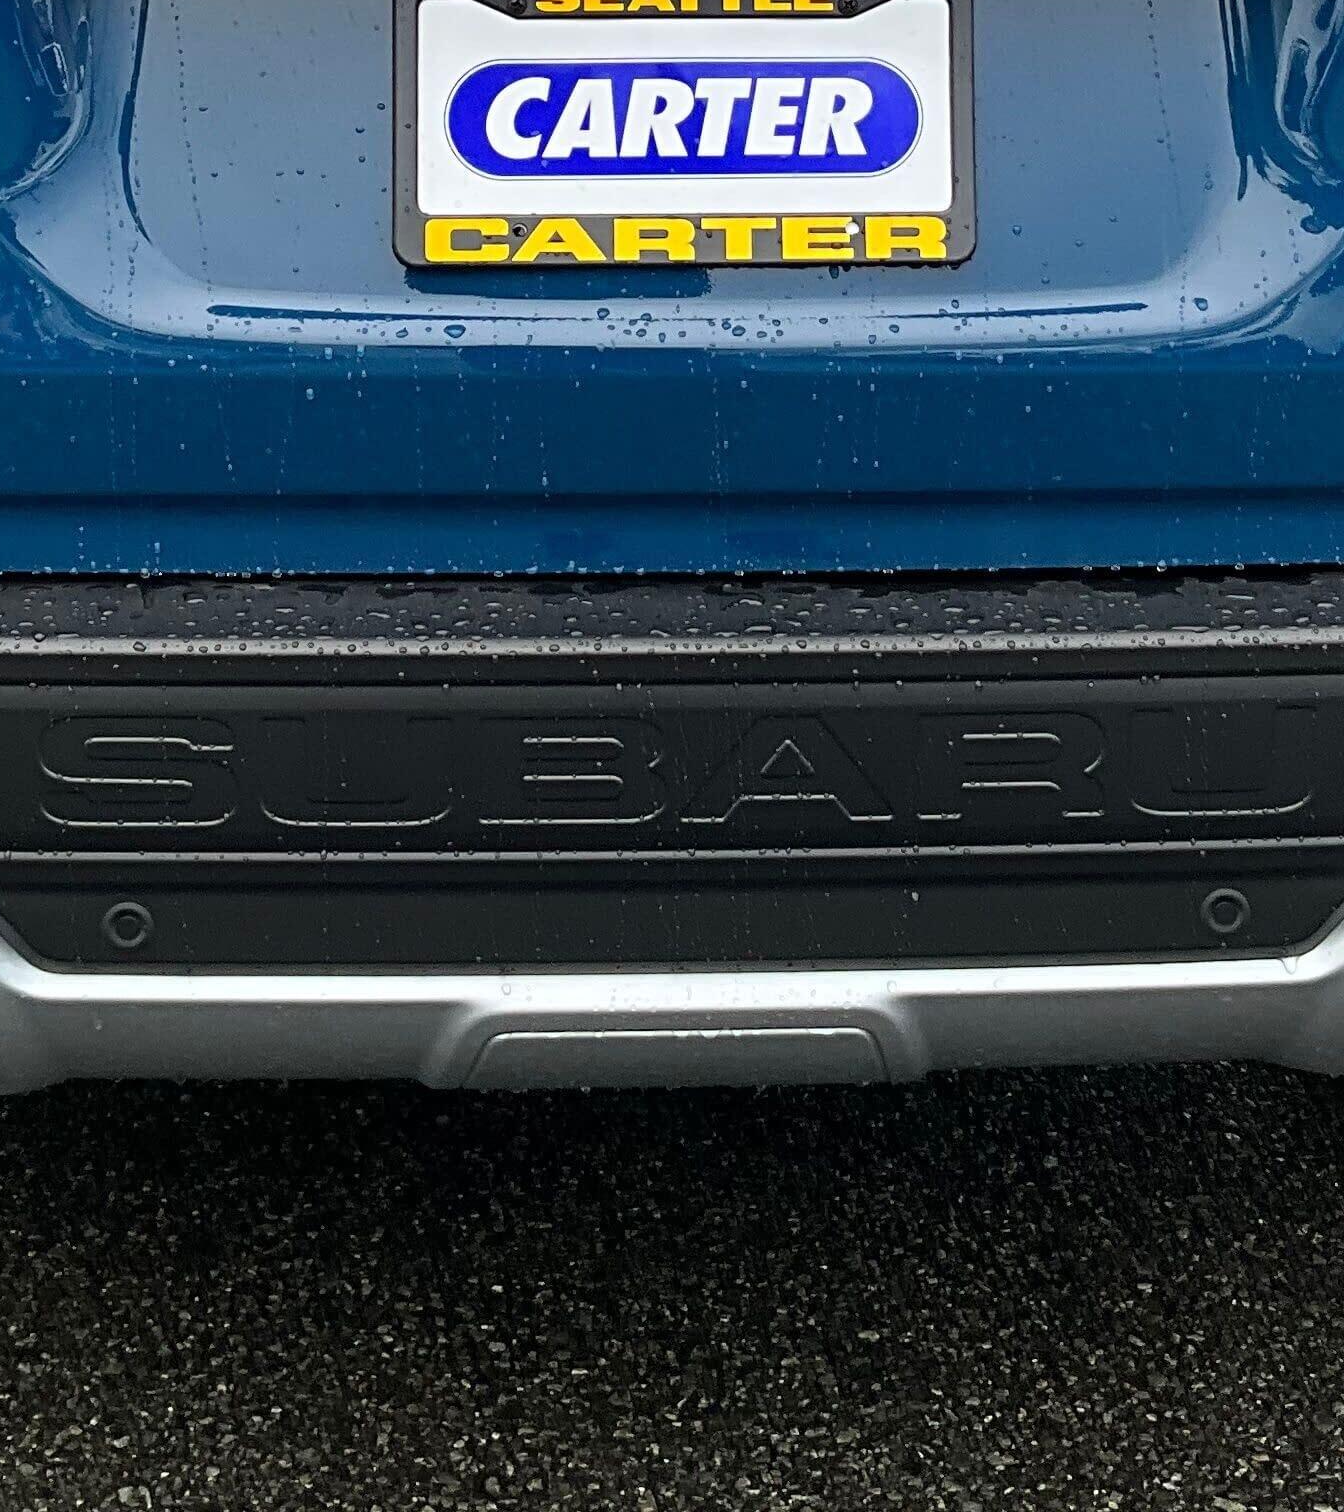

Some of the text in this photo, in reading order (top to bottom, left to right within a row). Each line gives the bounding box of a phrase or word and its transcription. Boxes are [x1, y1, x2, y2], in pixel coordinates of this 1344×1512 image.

[484, 76, 876, 159] CARTER
[423, 215, 949, 264] CARTER
[36, 706, 1317, 829] SUBARU
